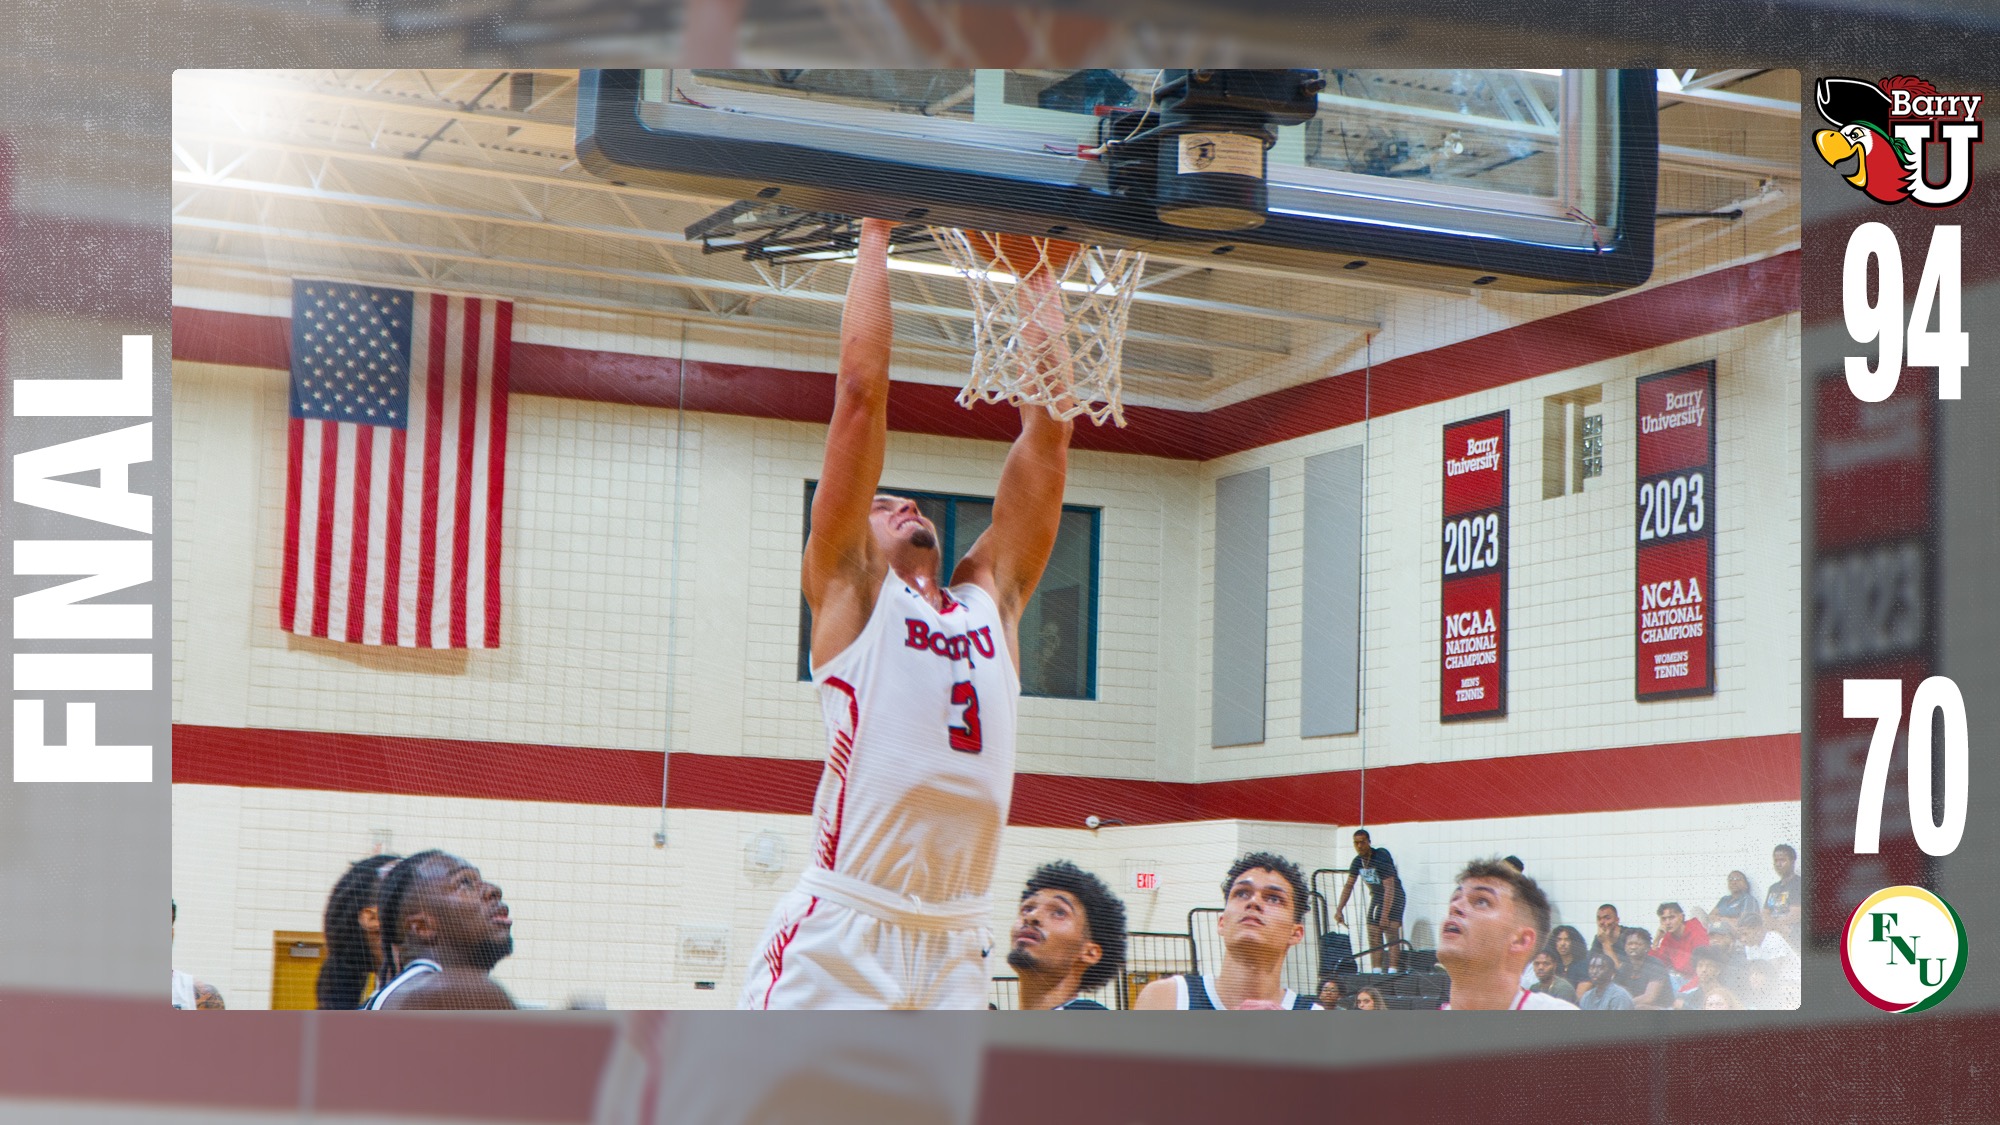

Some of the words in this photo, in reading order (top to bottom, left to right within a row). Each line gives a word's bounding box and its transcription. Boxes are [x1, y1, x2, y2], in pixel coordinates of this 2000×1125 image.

[1665, 389, 1704, 411] Barry
[1641, 406, 1705, 434] University
[1466, 436, 1499, 456] Barry
[1446, 453, 1500, 477] University
[1639, 473, 1704, 541] 2023
[1445, 513, 1498, 575] 2023
[1641, 577, 1702, 611] NCAA
[1445, 608, 1497, 639] NCAA
[1642, 605, 1703, 629] NATIONAL
[1641, 622, 1703, 644] CHAMPIONS
[1445, 634, 1497, 656] NATIONAL
[1445, 650, 1497, 670] CHAMPIONS
[1654, 650, 1689, 665] WOMEN'S
[1654, 663, 1689, 680] TENNIS
[1455, 687, 1485, 703] TENNIS
[948, 680, 982, 755] 3
[1136, 873, 1155, 889] EXIT
